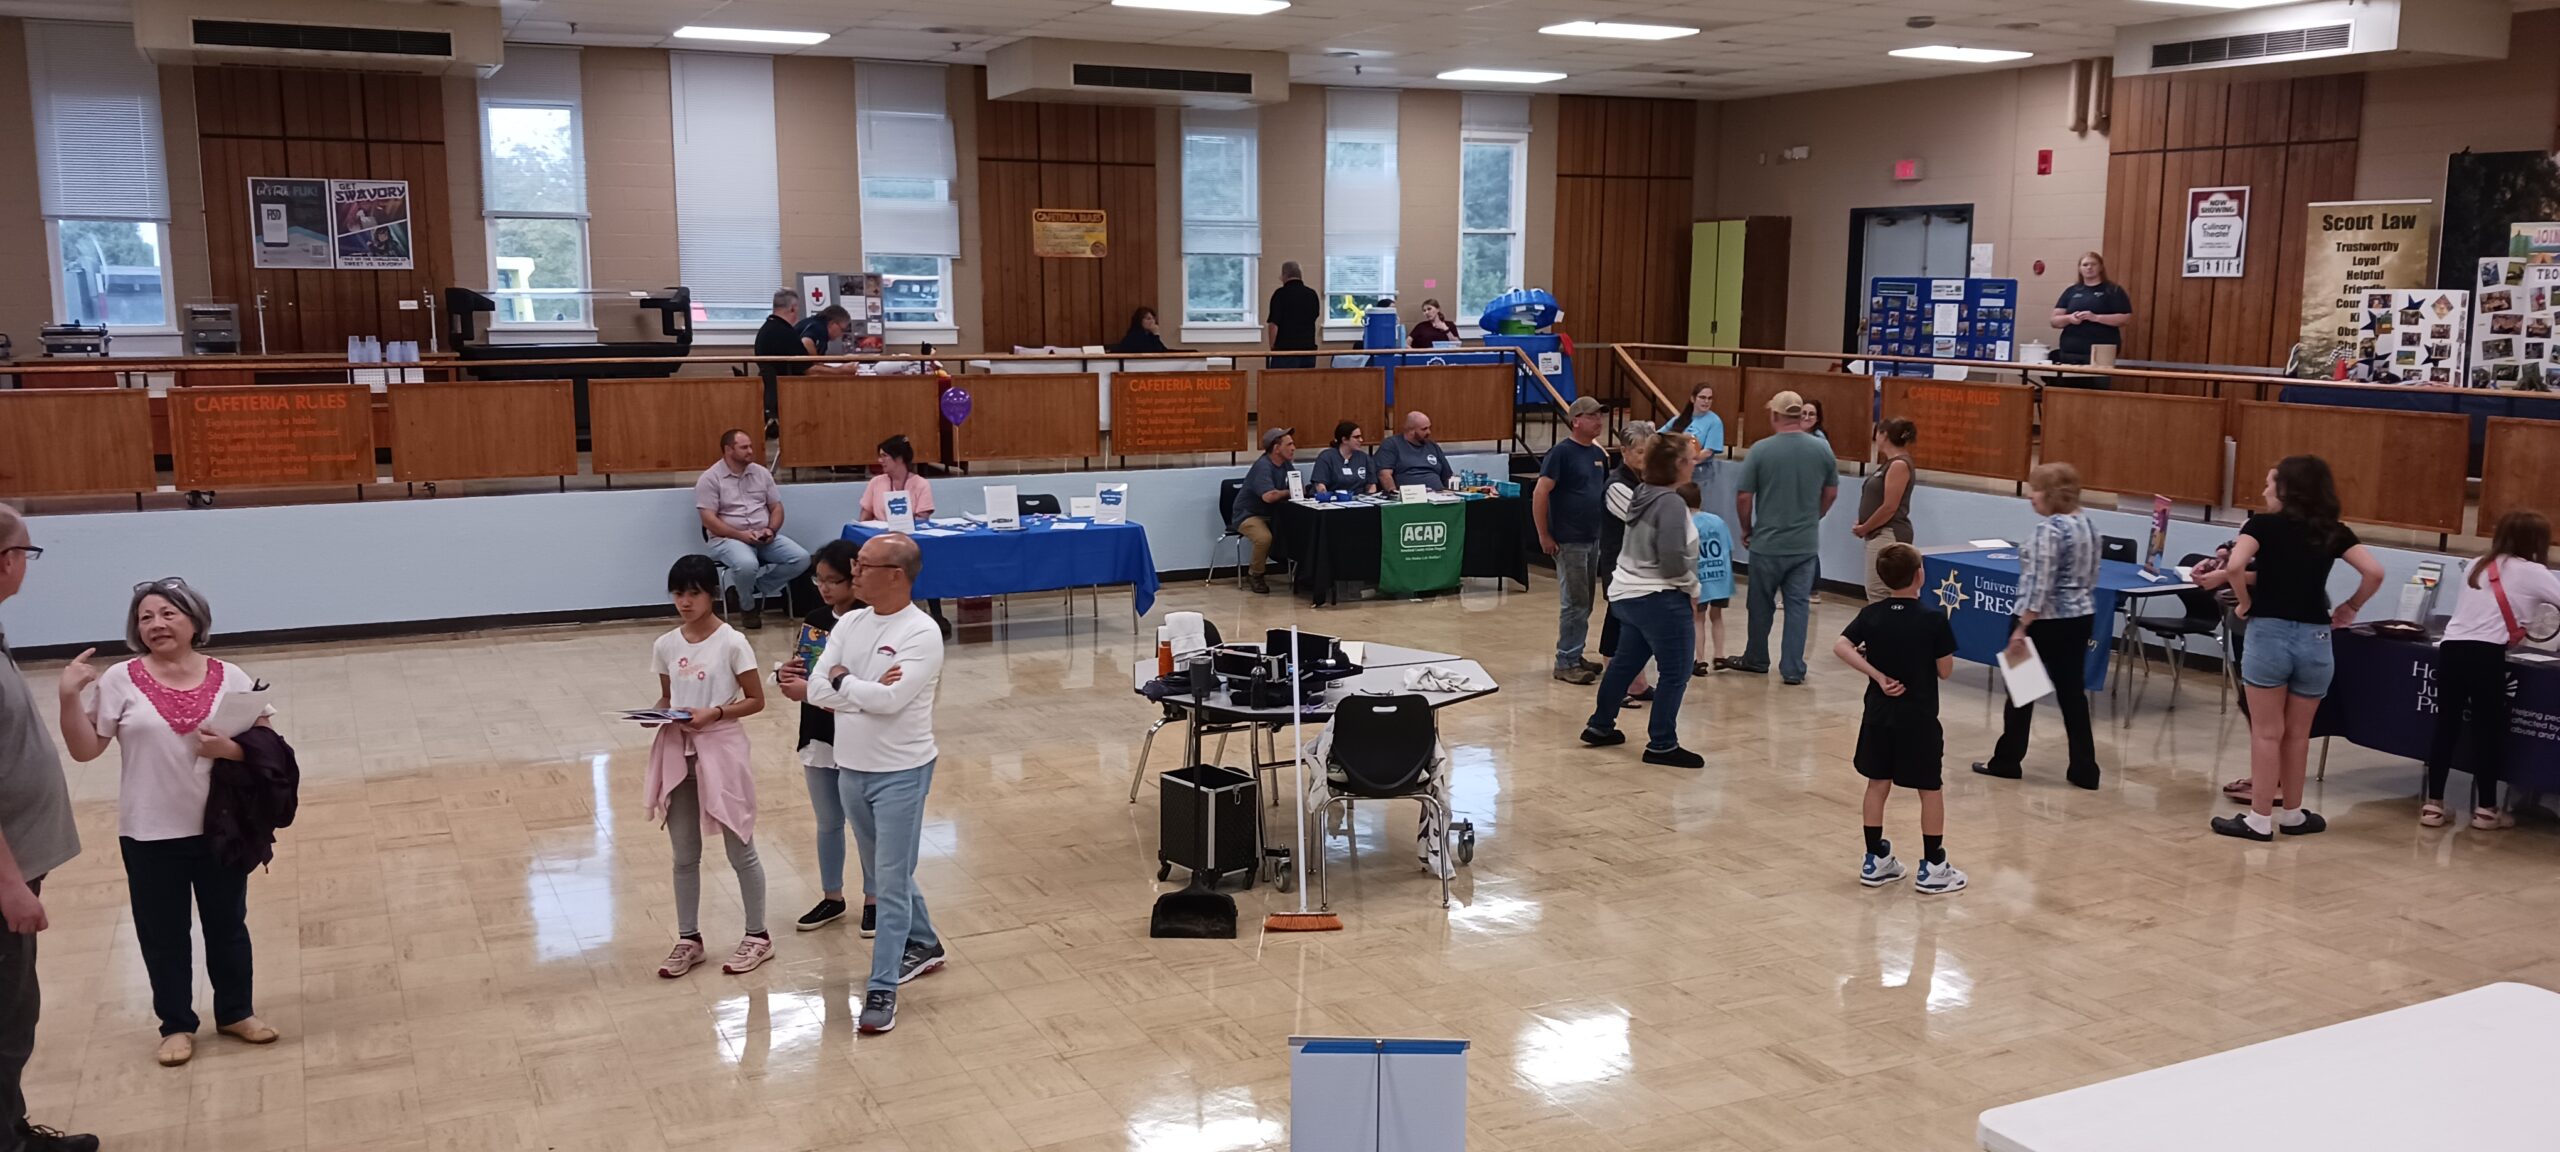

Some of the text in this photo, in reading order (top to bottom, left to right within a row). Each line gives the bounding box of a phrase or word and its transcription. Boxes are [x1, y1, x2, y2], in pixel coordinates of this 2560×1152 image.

[335, 186, 405, 202] SWAVORY
[2202, 223, 2231, 231] Culinary
[2323, 213, 2417, 231] Scout Law
[2203, 230, 2230, 238] Theater
[2336, 242, 2399, 252] Trustworthy
[2352, 256, 2380, 267] Loyal
[2346, 270, 2384, 281] Helpful
[1130, 377, 1232, 392] CAFETERIA RULES
[1908, 386, 2000, 406] CAFETERIA RULES
[194, 394, 347, 412] CAFETERIA RULES
[1403, 525, 1444, 543] ACAP
[1698, 570, 1725, 580] LIMIT
[1974, 590, 2014, 616] PRES
[2511, 707, 2543, 721] Helping
[2511, 717, 2548, 729] affected
[2537, 730, 2556, 740] and
